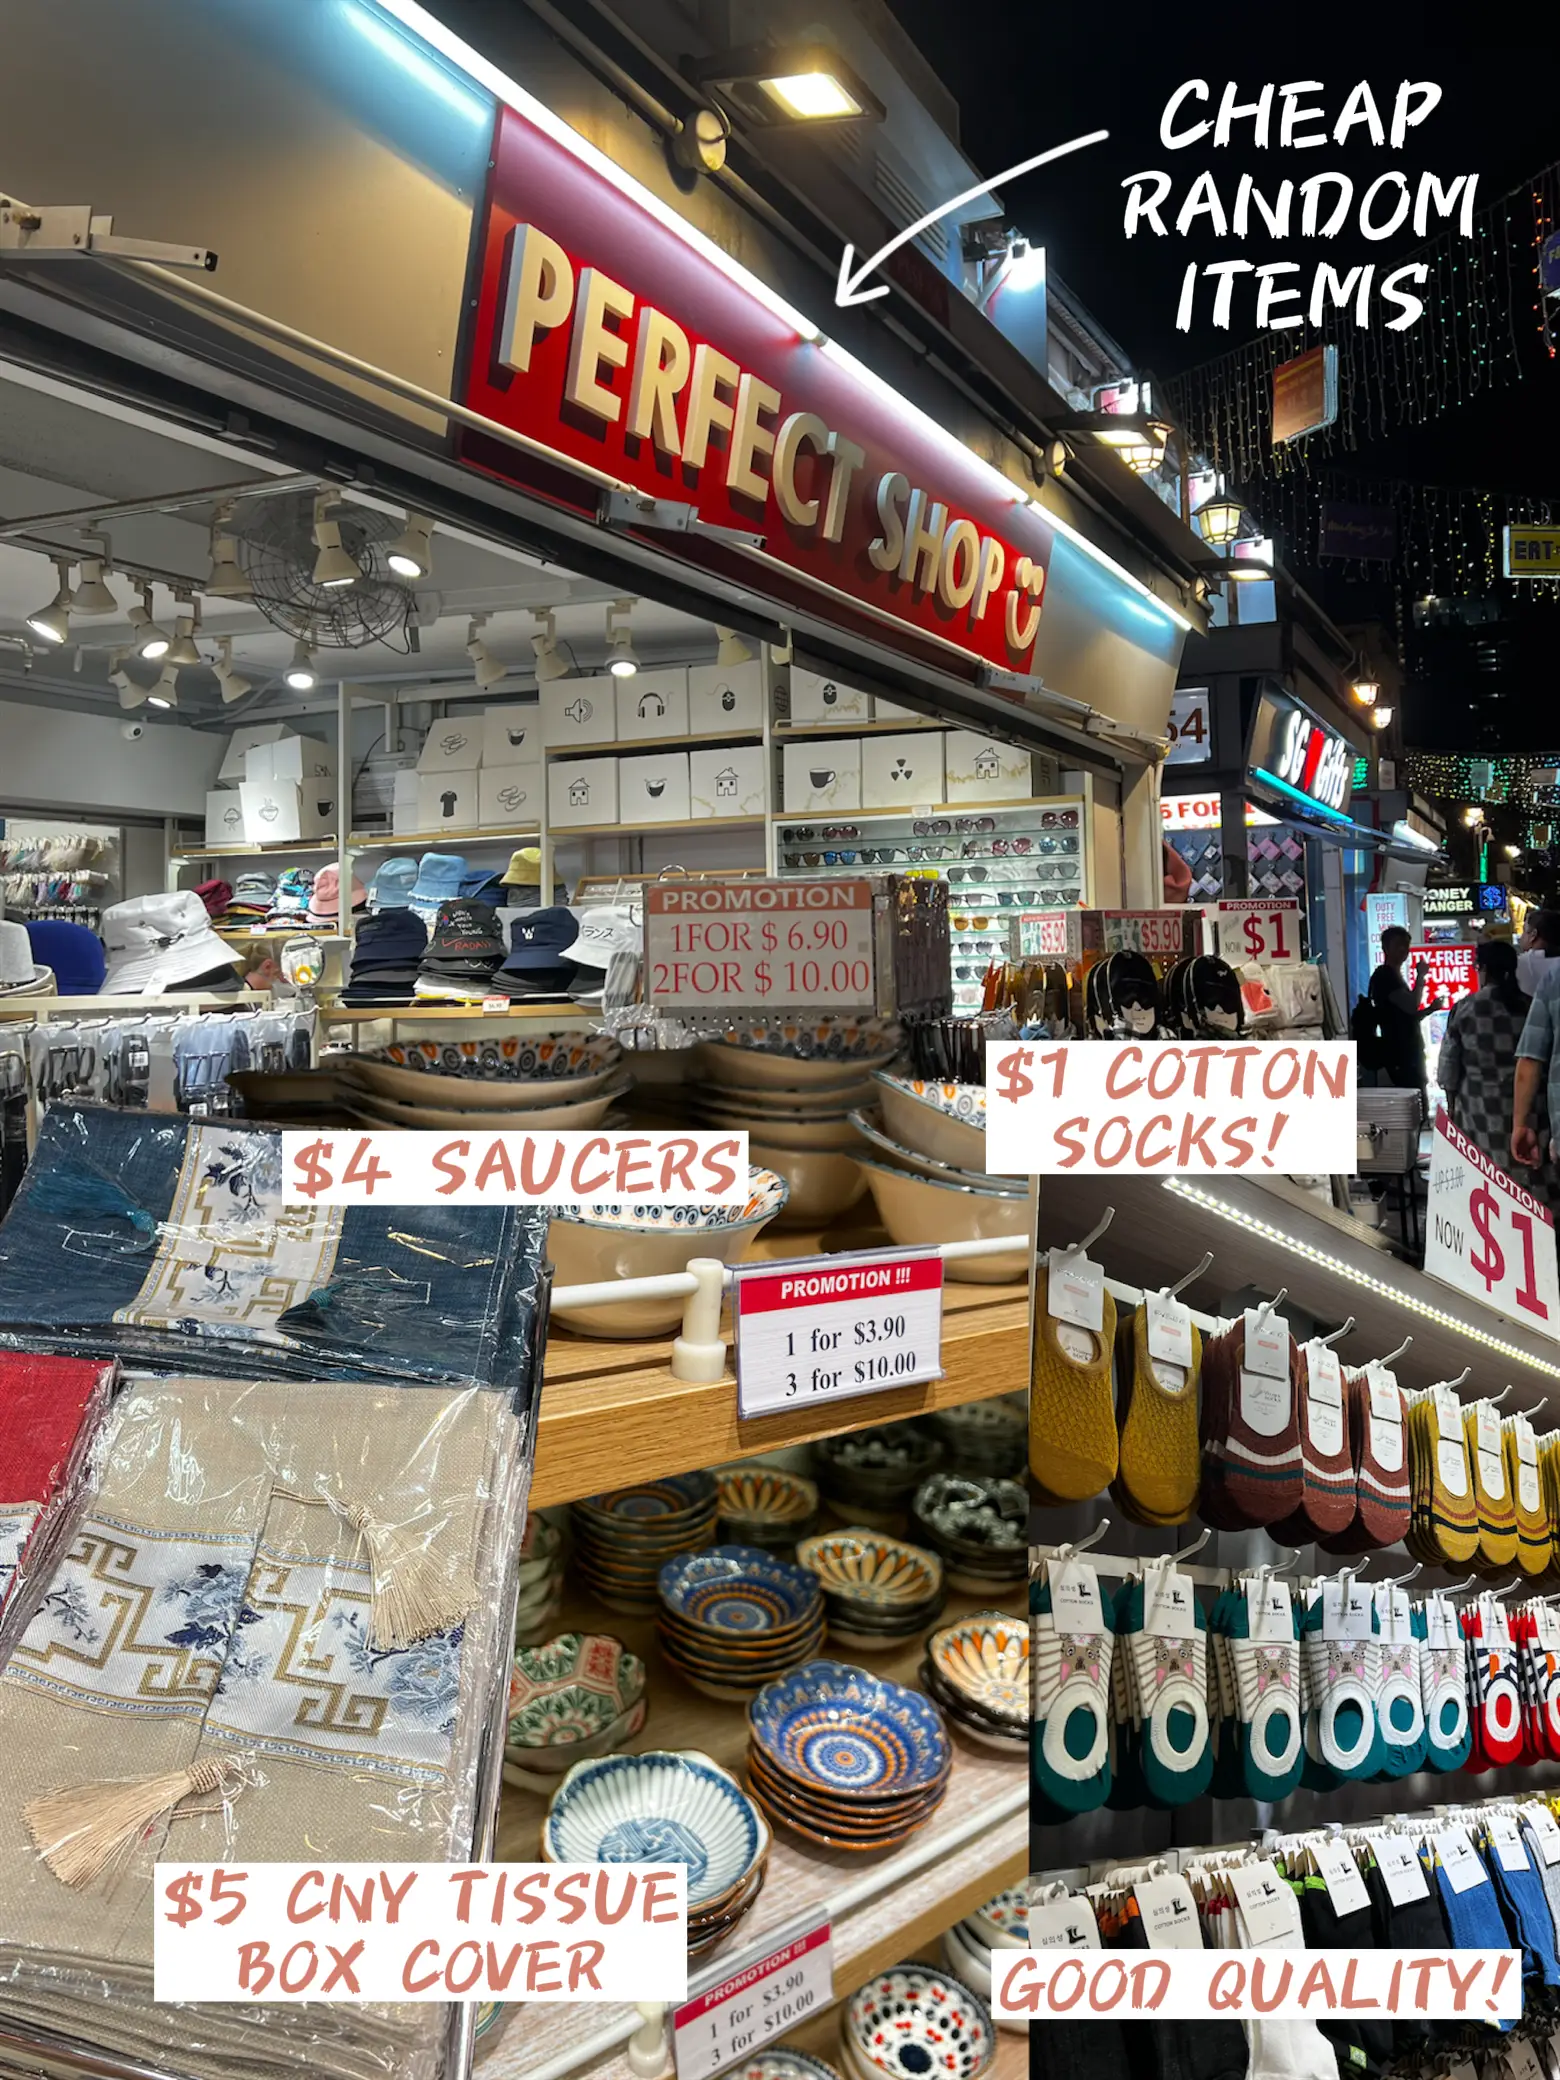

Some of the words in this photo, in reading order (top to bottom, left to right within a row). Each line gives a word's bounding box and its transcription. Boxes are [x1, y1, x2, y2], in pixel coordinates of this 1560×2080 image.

[499, 223, 866, 543] PERFECT
[868, 472, 1005, 620] SHOP
[1515, 541, 1554, 560] EAT
[1279, 709, 1310, 785] SG
[662, 886, 855, 911] PROMOTION
[1226, 901, 1291, 910] PROMOTION
[1375, 902, 1396, 912] DUTY
[1376, 913, 1396, 922] FREE
[582, 925, 614, 939] ランス
[671, 922, 752, 952] 1FOR
[761, 920, 778, 955] $
[788, 920, 848, 951] 6.90
[1041, 922, 1065, 952] $5.90
[1141, 919, 1180, 951] $5.90
[1243, 912, 1291, 960] $1
[653, 962, 745, 994] 2FOR
[755, 960, 773, 997] $
[784, 960, 870, 993] 10.00
[1446, 1122, 1545, 1220] PROMOTION
[1436, 1213, 1464, 1256] NOW
[1469, 1179, 1548, 1320] $1
[781, 1269, 891, 1299] PROMOTION
[895, 1267, 911, 1285] !!!
[786, 1332, 795, 1357] 1
[810, 1328, 842, 1352] for
[854, 1315, 906, 1345] $3.90
[785, 1373, 797, 1396] 3
[811, 1368, 842, 1391] for
[854, 1351, 916, 1383] $10.00
[704, 1948, 791, 2007] PROMOTION
[710, 2022, 717, 2039] 1
[729, 2004, 754, 2027] for
[762, 1971, 804, 2007] $3.90
[711, 2048, 721, 2066] 3
[731, 2029, 755, 2053] for
[764, 1990, 814, 2032] $10.00
